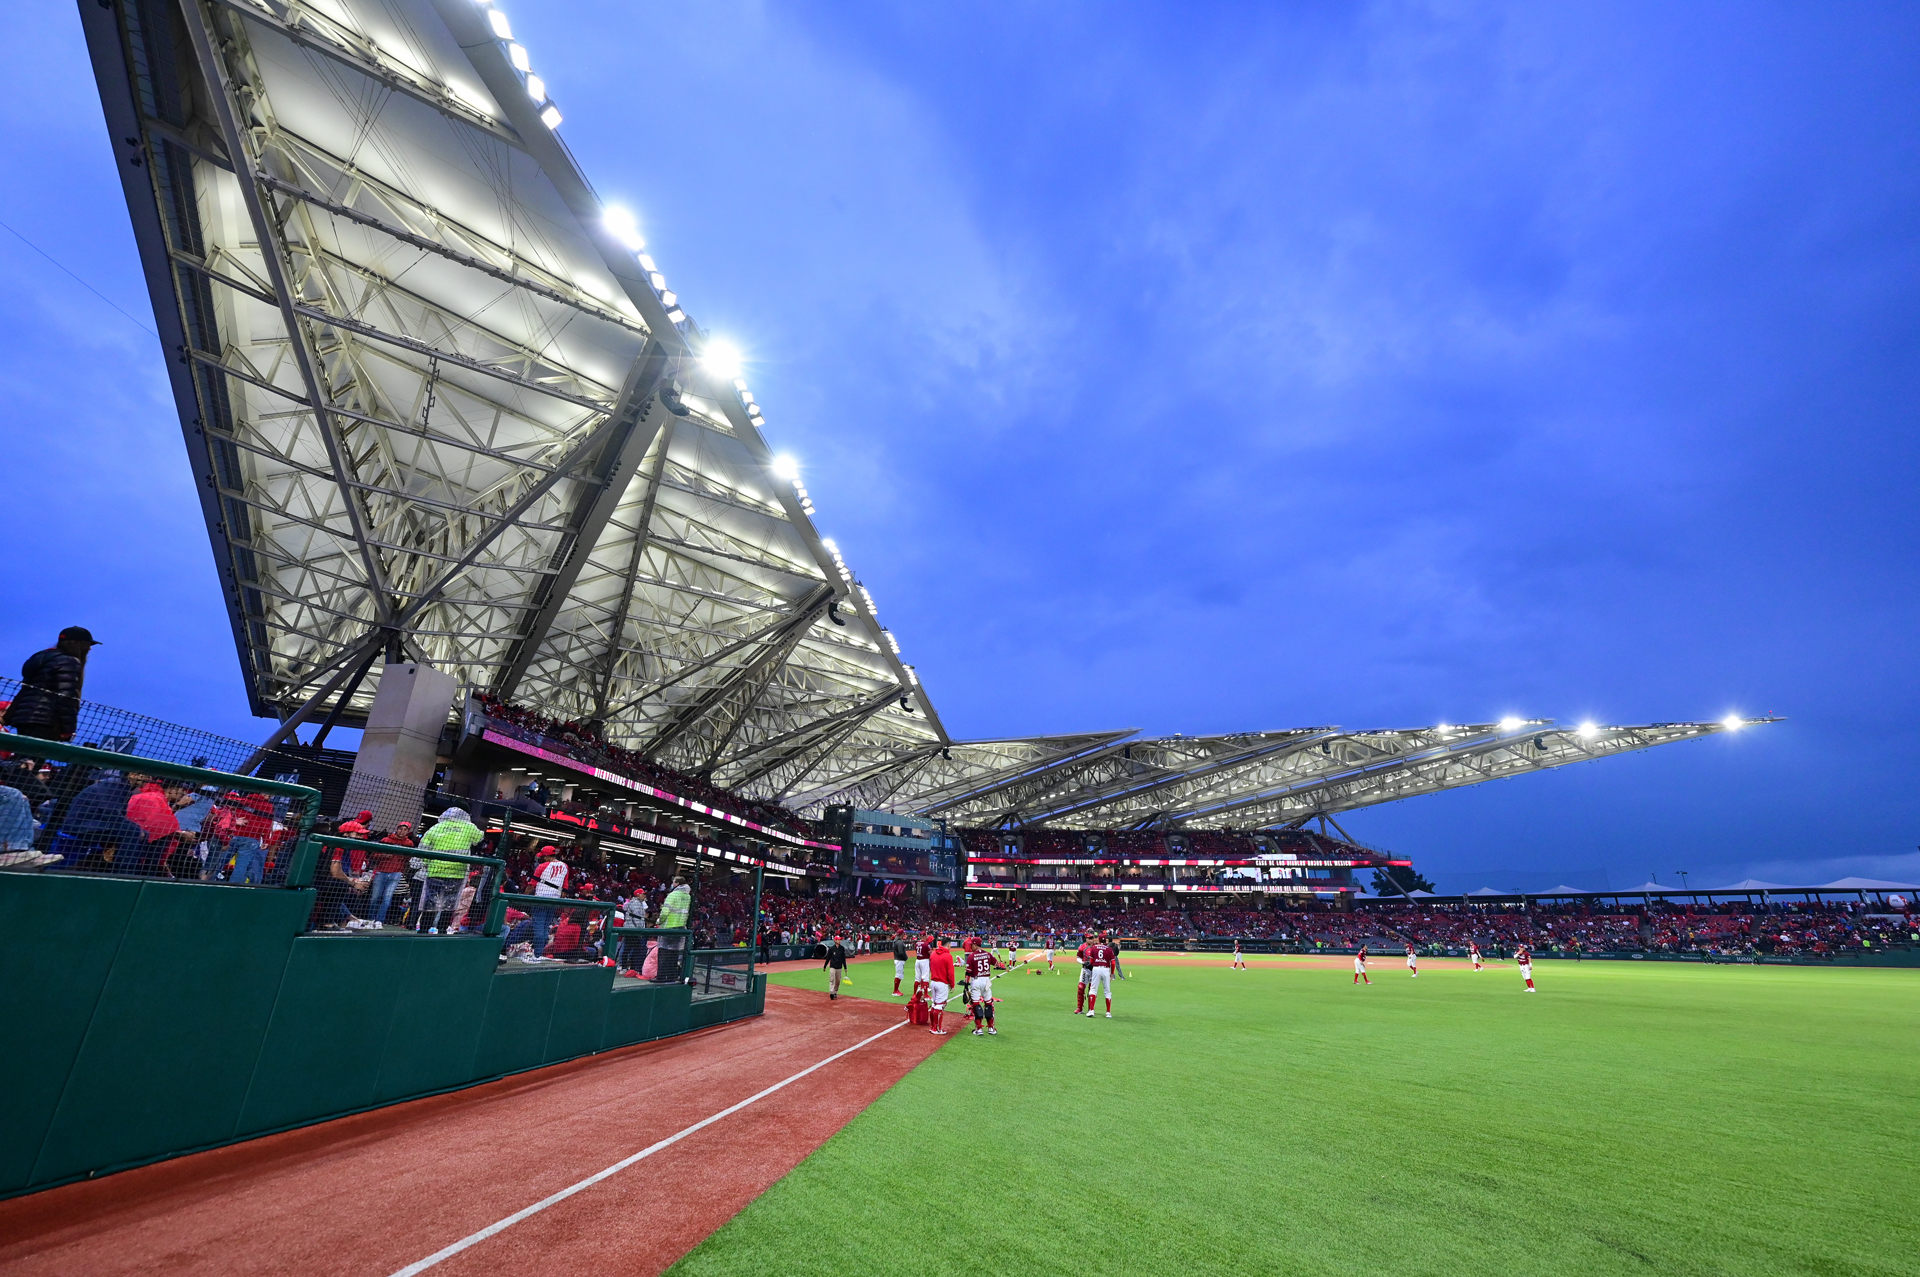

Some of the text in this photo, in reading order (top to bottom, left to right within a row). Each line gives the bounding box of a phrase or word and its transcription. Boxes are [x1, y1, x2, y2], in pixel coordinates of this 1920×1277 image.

[101, 737, 133, 753] A7
[1098, 949, 1104, 959] 6
[977, 959, 990, 972] 55
